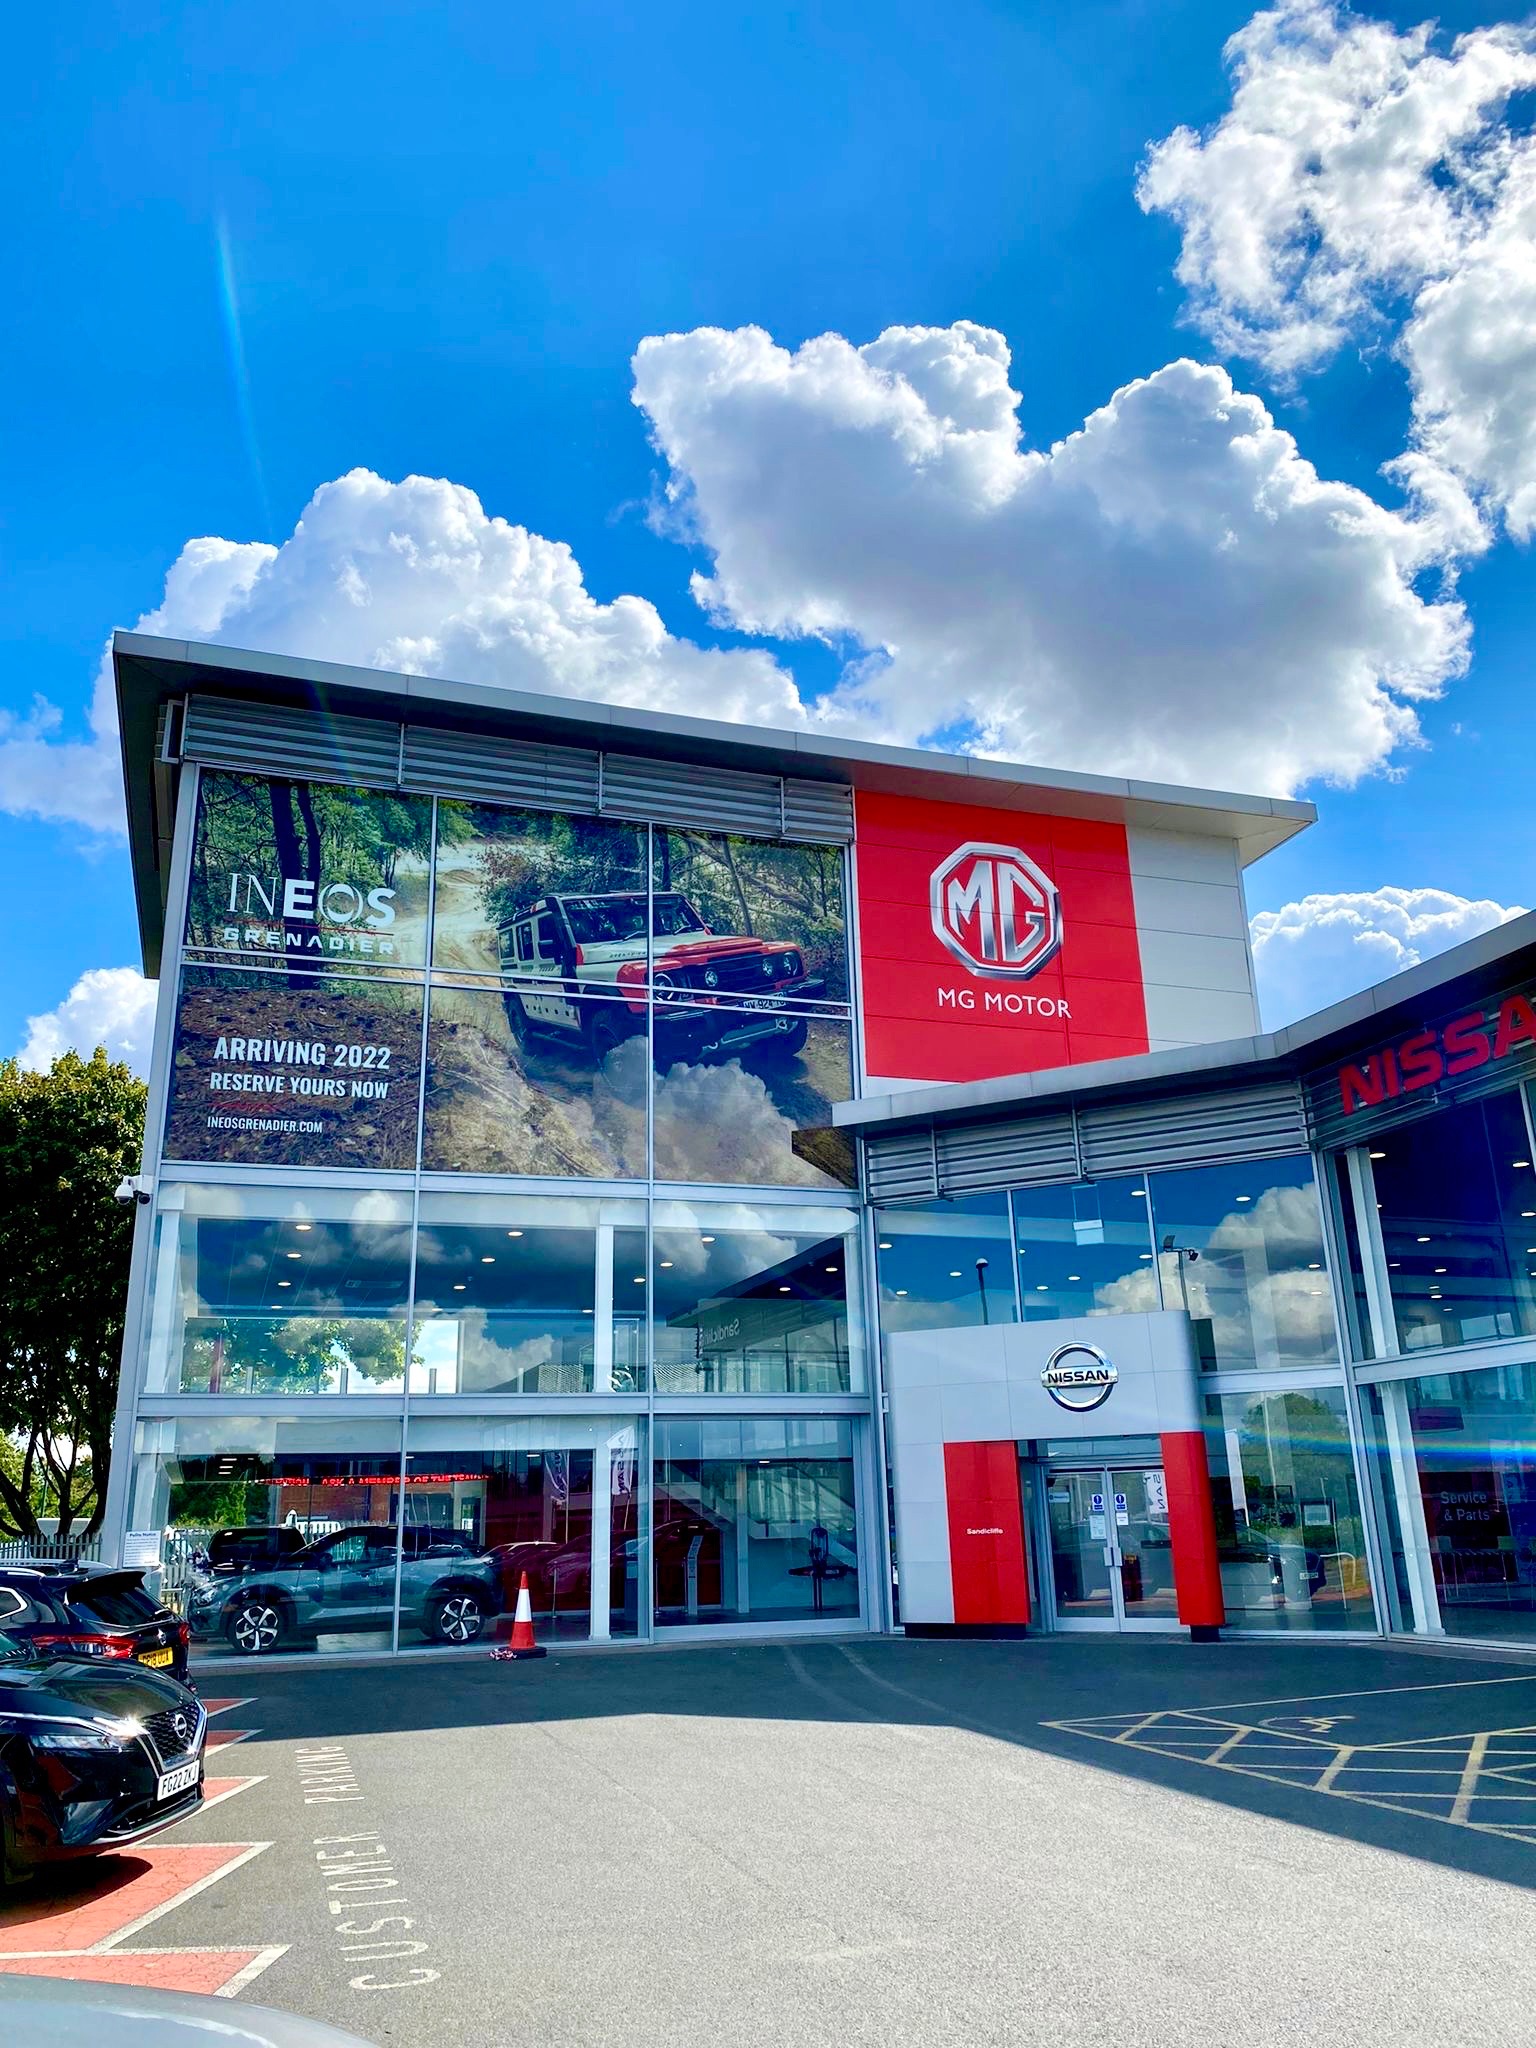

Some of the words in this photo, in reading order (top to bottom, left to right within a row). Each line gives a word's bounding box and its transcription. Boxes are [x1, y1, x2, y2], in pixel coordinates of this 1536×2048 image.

[225, 872, 396, 928] INEOS
[223, 927, 395, 955] GRENADIER
[937, 987, 975, 1009] MG
[984, 991, 1072, 1019] MOTOR
[213, 1036, 327, 1066] ARRIVING
[333, 1044, 392, 1070] 2022
[1338, 994, 1536, 1116] NISSA
[209, 1072, 285, 1094] RESERVE
[290, 1077, 346, 1098] YOURS
[351, 1081, 389, 1099] NOW
[207, 1116, 323, 1134] INEOSGRENADIER.COM
[1047, 1369, 1109, 1384] NISSAN
[1440, 1491, 1488, 1504] Service
[1444, 1508, 1453, 1521] &
[1456, 1508, 1490, 1521] Parts
[161, 1770, 183, 1796] FG22
[294, 1746, 365, 1804] PARKING
[313, 1831, 442, 1991] CUSTOMER
